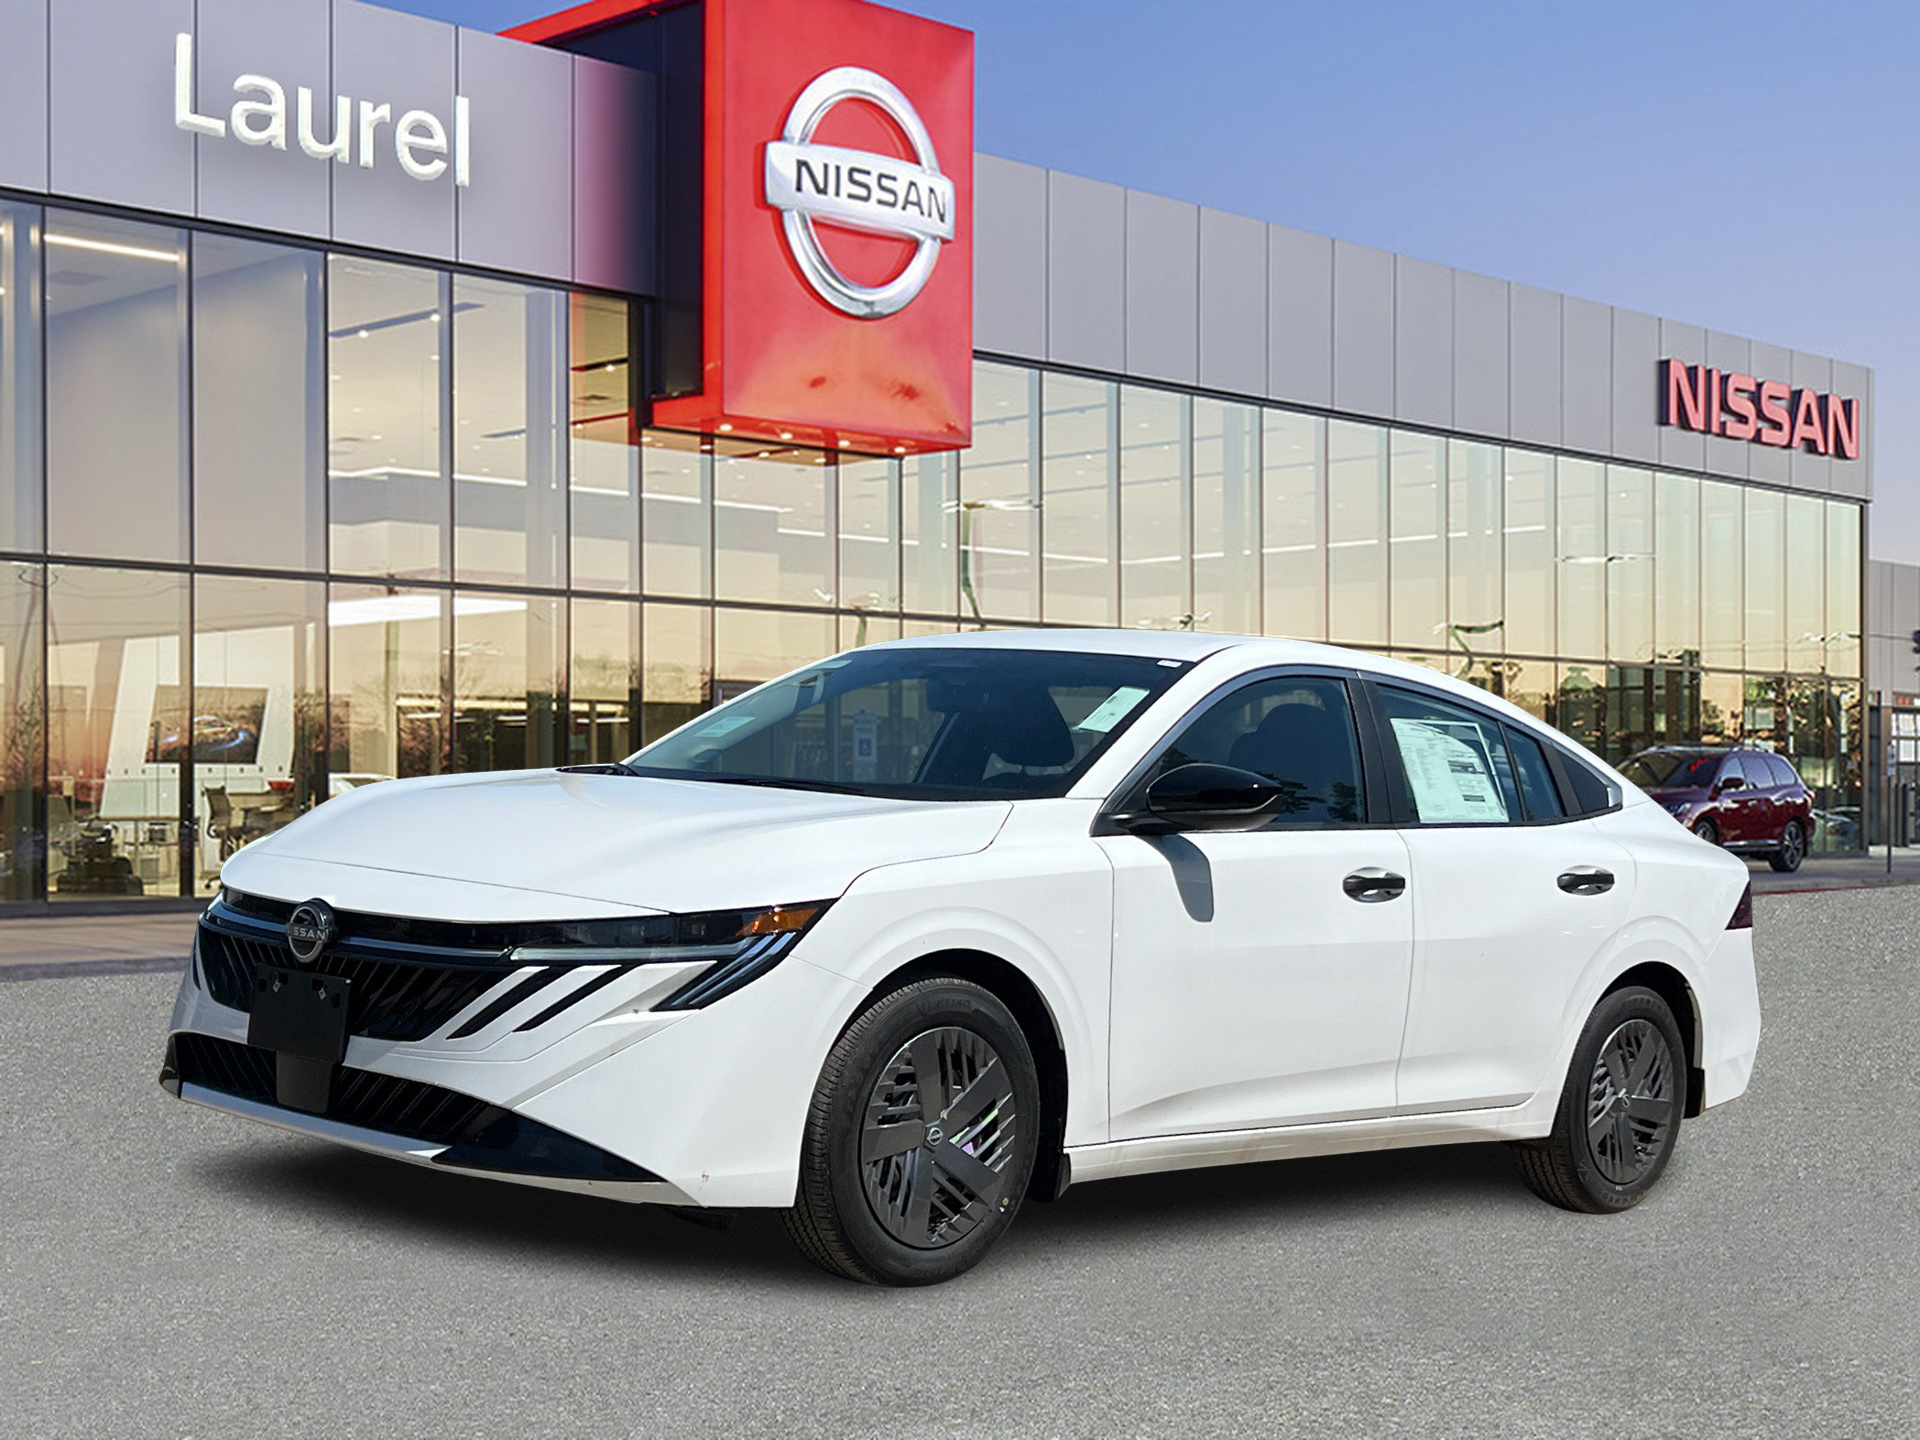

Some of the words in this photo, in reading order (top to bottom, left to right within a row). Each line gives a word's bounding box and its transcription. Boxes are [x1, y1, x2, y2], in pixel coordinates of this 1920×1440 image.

[174, 33, 471, 188] Laurel
[794, 158, 948, 224] NISSAN
[1660, 358, 1860, 460] NISSAN
[287, 926, 326, 940] SSAN
